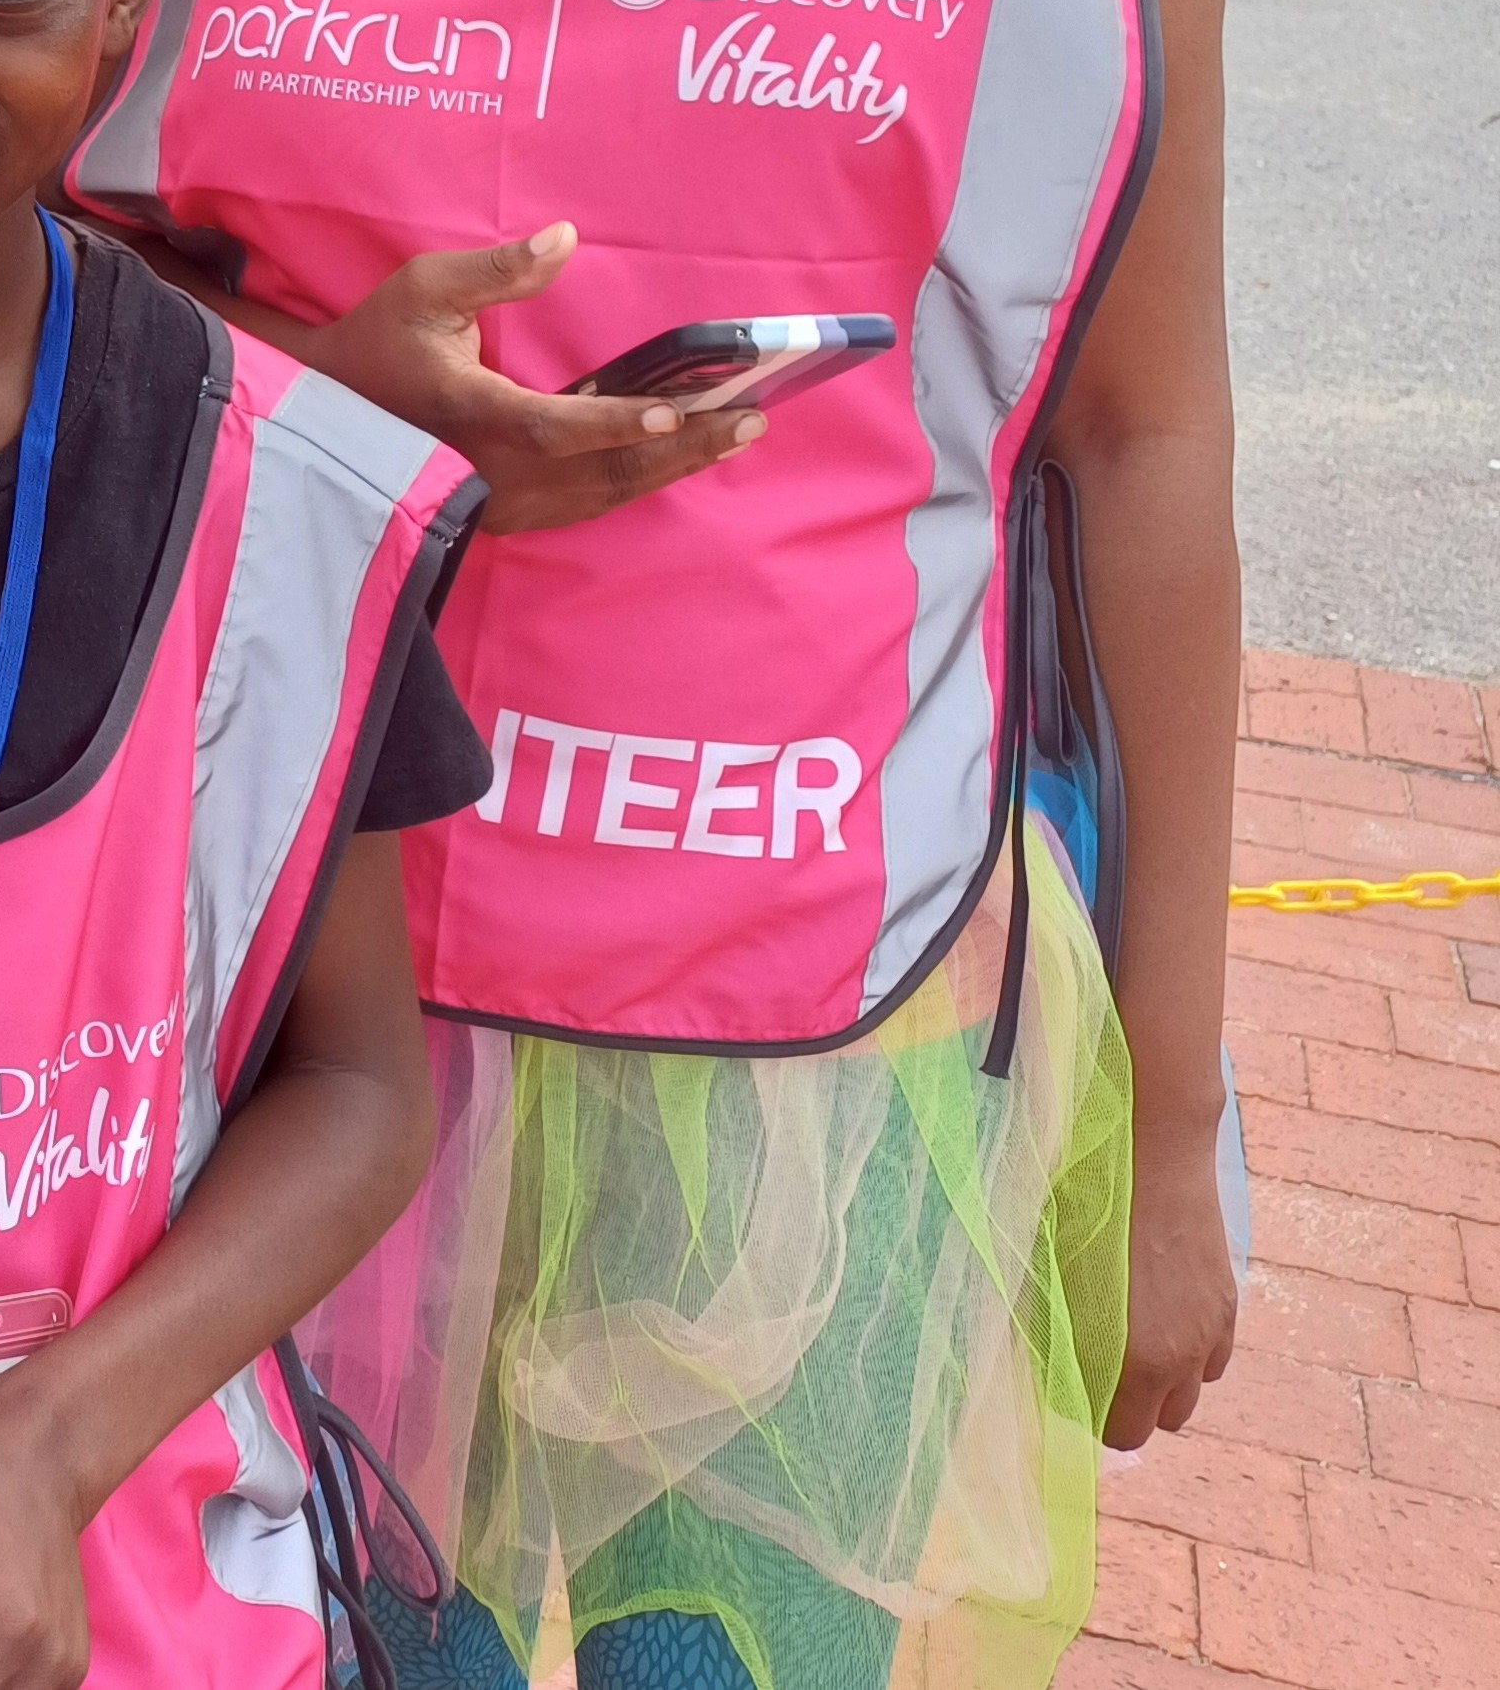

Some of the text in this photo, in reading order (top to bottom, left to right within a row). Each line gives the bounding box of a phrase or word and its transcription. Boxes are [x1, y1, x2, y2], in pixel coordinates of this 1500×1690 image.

[233, 70, 504, 116] IN PARTNERSHIP WITH
[677, 11, 909, 145] Vitality
